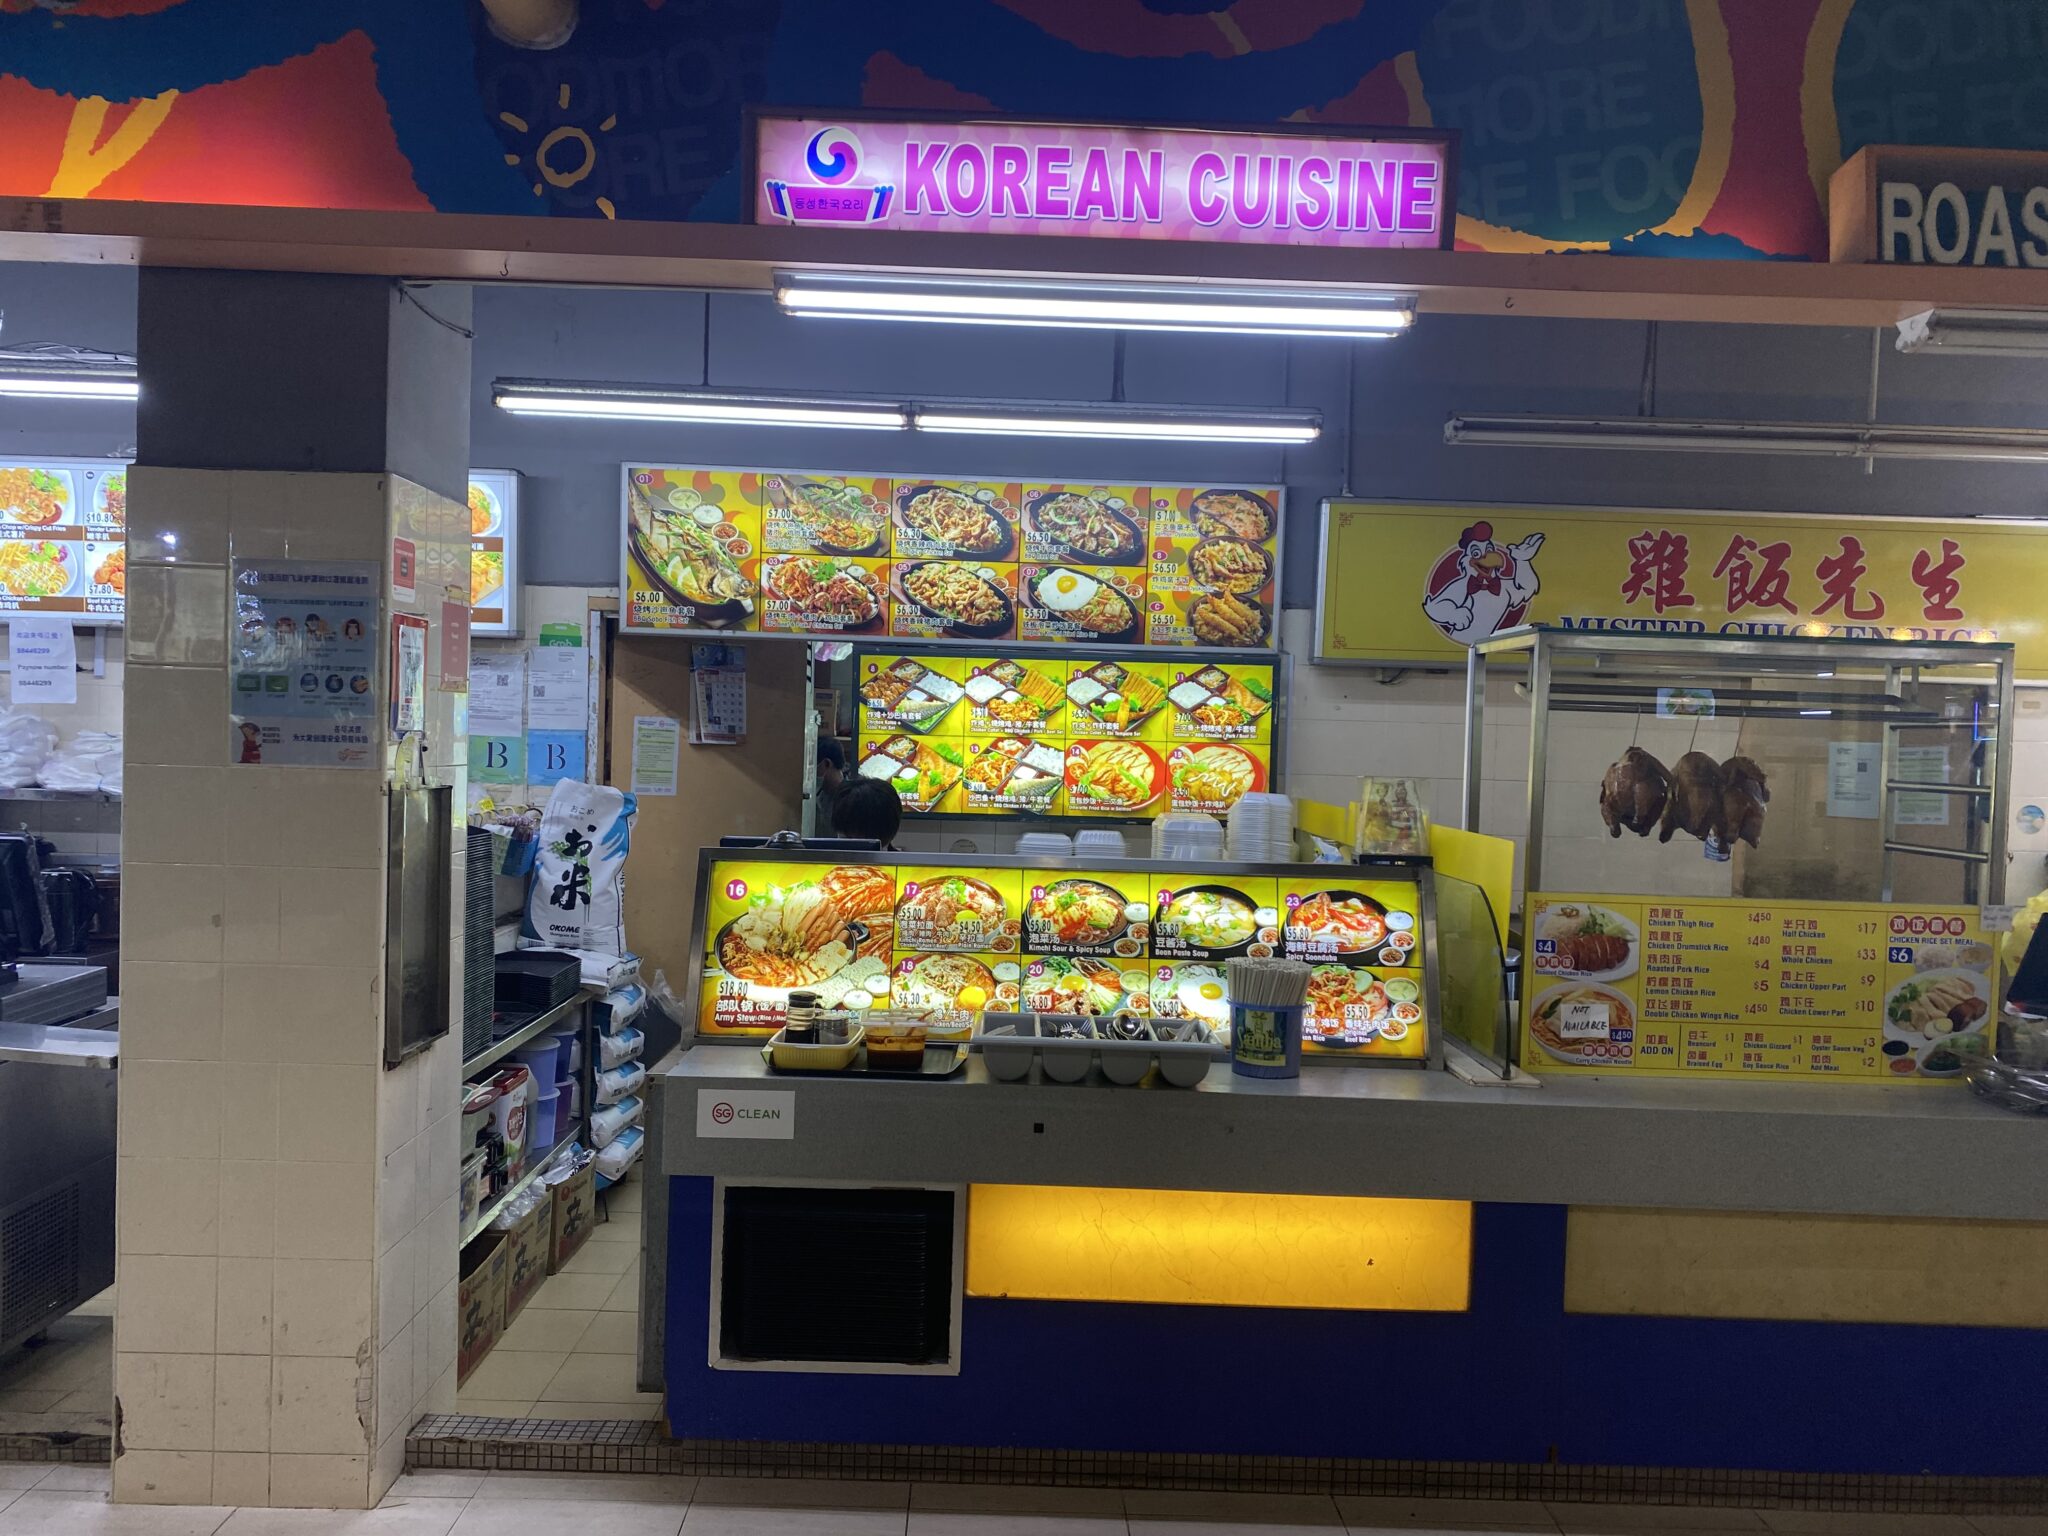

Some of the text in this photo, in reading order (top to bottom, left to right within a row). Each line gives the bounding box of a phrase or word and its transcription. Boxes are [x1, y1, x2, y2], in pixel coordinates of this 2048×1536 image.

[904, 141, 1438, 233] KOREAN CUISINE
[1881, 182, 2048, 268] ROAS
[768, 509, 791, 518] $7.00
[897, 529, 920, 538] $6.30
[1027, 533, 1049, 542] $6.50
[1154, 564, 1176, 573] $6.50
[1620, 529, 1968, 622] 雞飯先生
[635, 592, 660, 602] $6.00
[766, 600, 789, 610] $7.00
[896, 605, 919, 615] $6.30
[1024, 609, 1047, 619] $5.50
[1152, 615, 1174, 625] $6.50
[485, 742, 508, 768] B
[546, 744, 566, 770] B
[728, 884, 745, 896] 16
[905, 885, 917, 895] 17
[1032, 889, 1045, 899] 19
[1158, 893, 1170, 903] 21
[1286, 896, 1300, 906] 23
[901, 908, 922, 918] $5.00
[550, 924, 581, 934] OKOME
[960, 921, 980, 932] $4.50
[1031, 920, 1051, 931] $5.80
[1678, 920, 1697, 928] Thigh
[1698, 920, 1714, 928] Rice
[1858, 923, 1877, 934] $17
[1158, 924, 1179, 935] $5.80
[1288, 928, 1308, 939] $5.80
[1029, 933, 1060, 944] 泡菜汤
[1076, 946, 1093, 954] Spicy
[1538, 941, 1552, 952] $4
[1677, 943, 1711, 951] Drumstick
[1286, 953, 1304, 961] Spicy
[1857, 949, 1876, 960] $33
[1892, 949, 1909, 962] $6
[1754, 960, 1770, 970] $4
[1781, 956, 1804, 964] Whole
[902, 961, 913, 970] 18
[1029, 965, 1043, 974] 20
[1158, 969, 1171, 979] 22
[1860, 974, 1876, 986] $9
[719, 981, 748, 996] $18.80
[1754, 980, 1769, 992] $5
[1809, 982, 1830, 991] Upper
[1832, 983, 1847, 991] Part
[898, 992, 920, 1005] $6.30
[1026, 996, 1048, 1008] $6.80
[1158, 1001, 1178, 1013] $6.30
[1571, 1006, 1590, 1015] NOT
[1855, 1000, 1875, 1012] $10
[1346, 1006, 1367, 1018] $5.50
[1700, 1012, 1722, 1020] Wings
[1724, 1012, 1739, 1020] Rice
[715, 1013, 755, 1023] Army Stew
[1562, 1021, 1608, 1032] AVAILABLE
[1864, 1037, 1875, 1047] $3
[1640, 1047, 1674, 1055] ADD ON
[1862, 1057, 1875, 1067] $2
[715, 1108, 780, 1119] SG CLEAN
